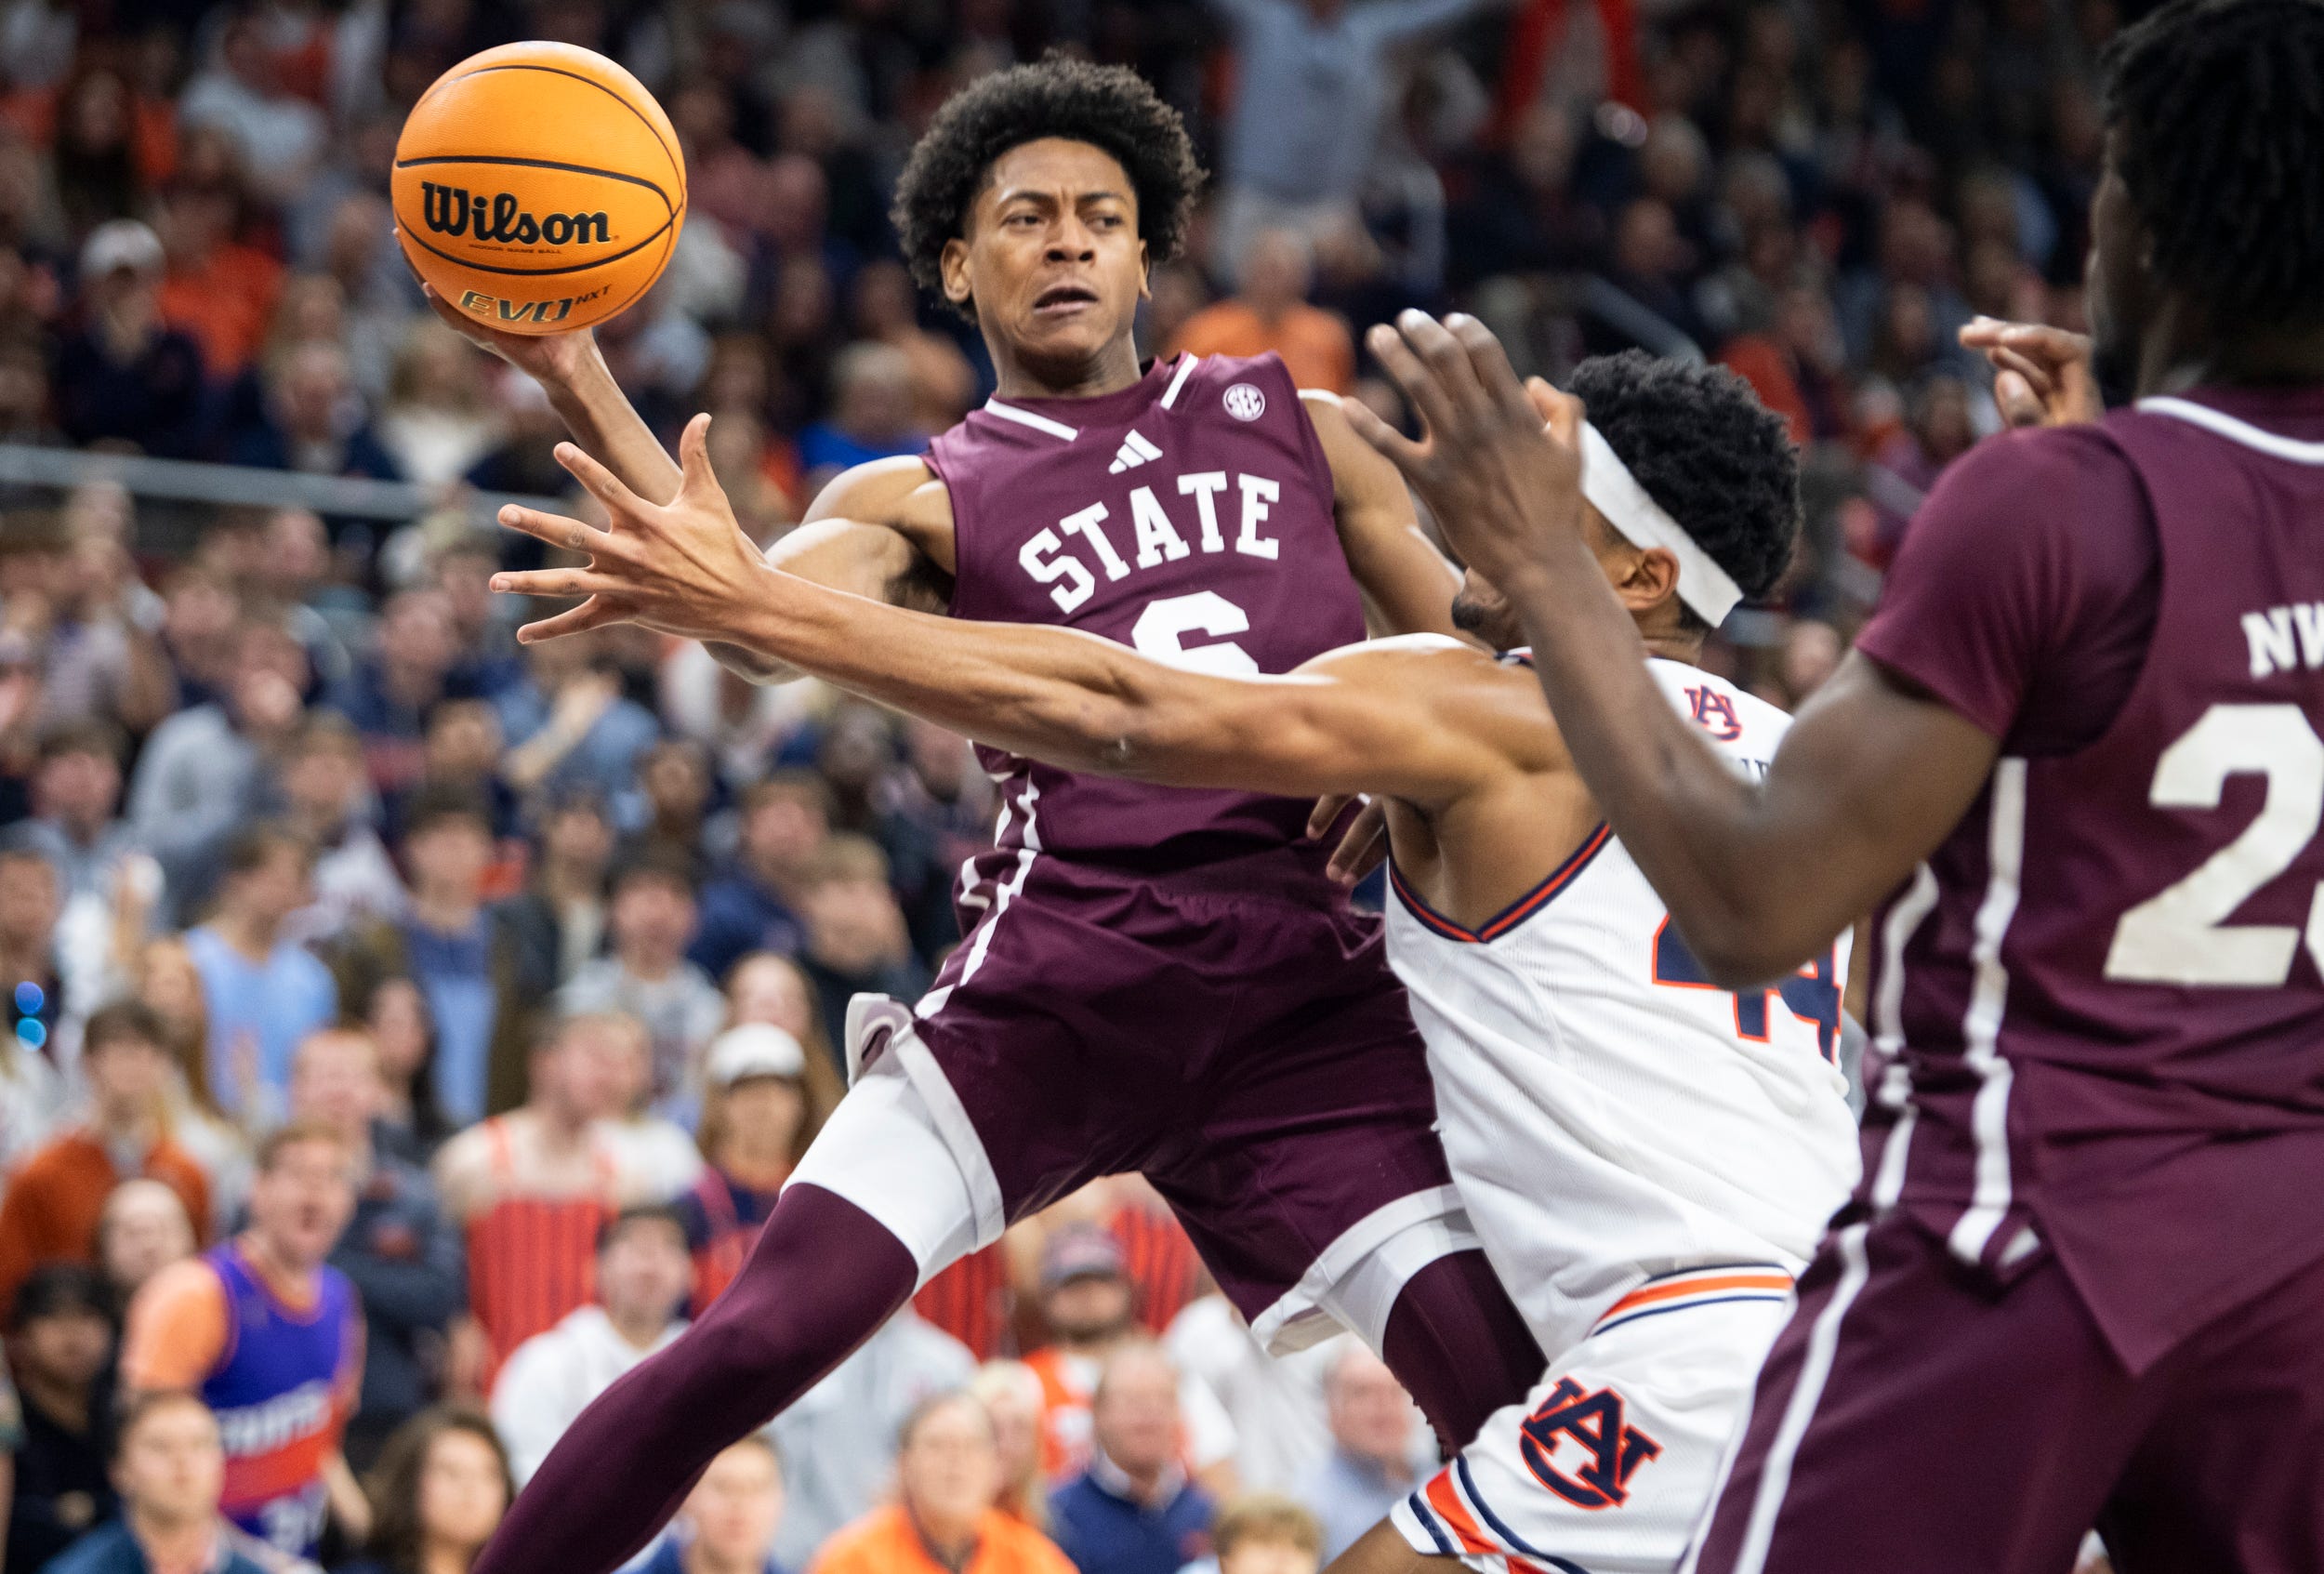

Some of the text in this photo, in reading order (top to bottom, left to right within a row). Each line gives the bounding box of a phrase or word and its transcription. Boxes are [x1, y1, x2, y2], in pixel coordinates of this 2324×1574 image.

[421, 181, 611, 245] Wilson
[459, 284, 612, 323] EVO NXT
[1225, 385, 1262, 418] SEC
[1019, 470, 1280, 615] STATE
